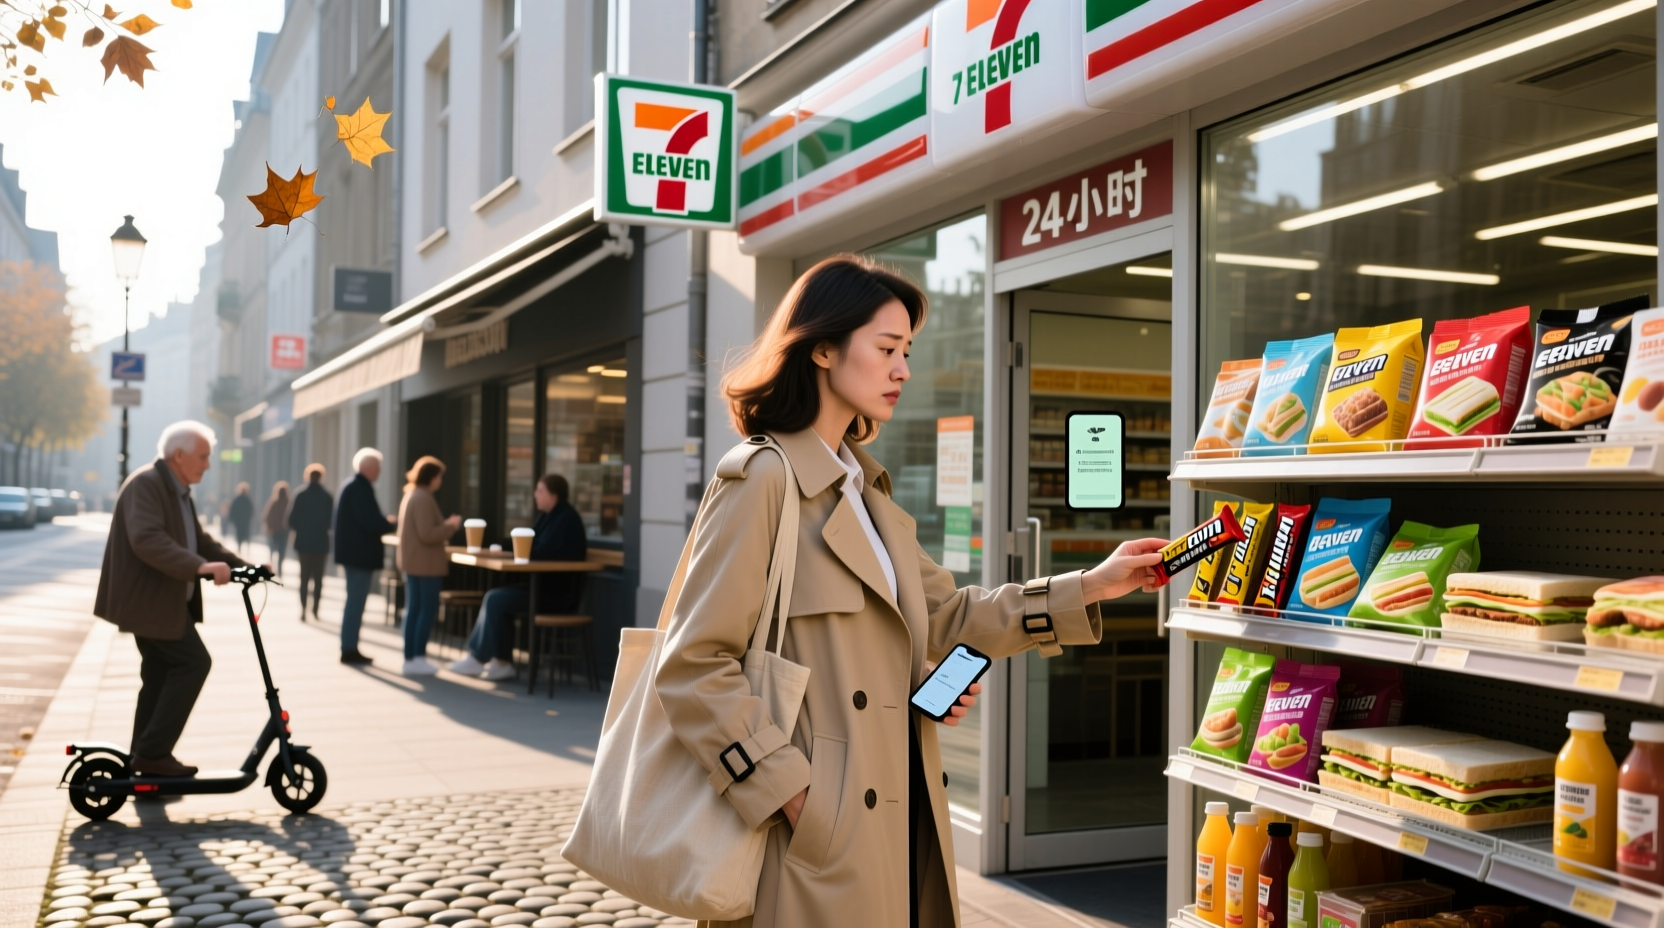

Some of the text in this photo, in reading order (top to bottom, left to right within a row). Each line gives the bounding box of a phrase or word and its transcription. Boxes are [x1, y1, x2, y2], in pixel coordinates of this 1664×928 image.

[952, 70, 963, 105] 7
[634, 101, 709, 212] 7
[1021, 158, 1147, 247] 24小时
